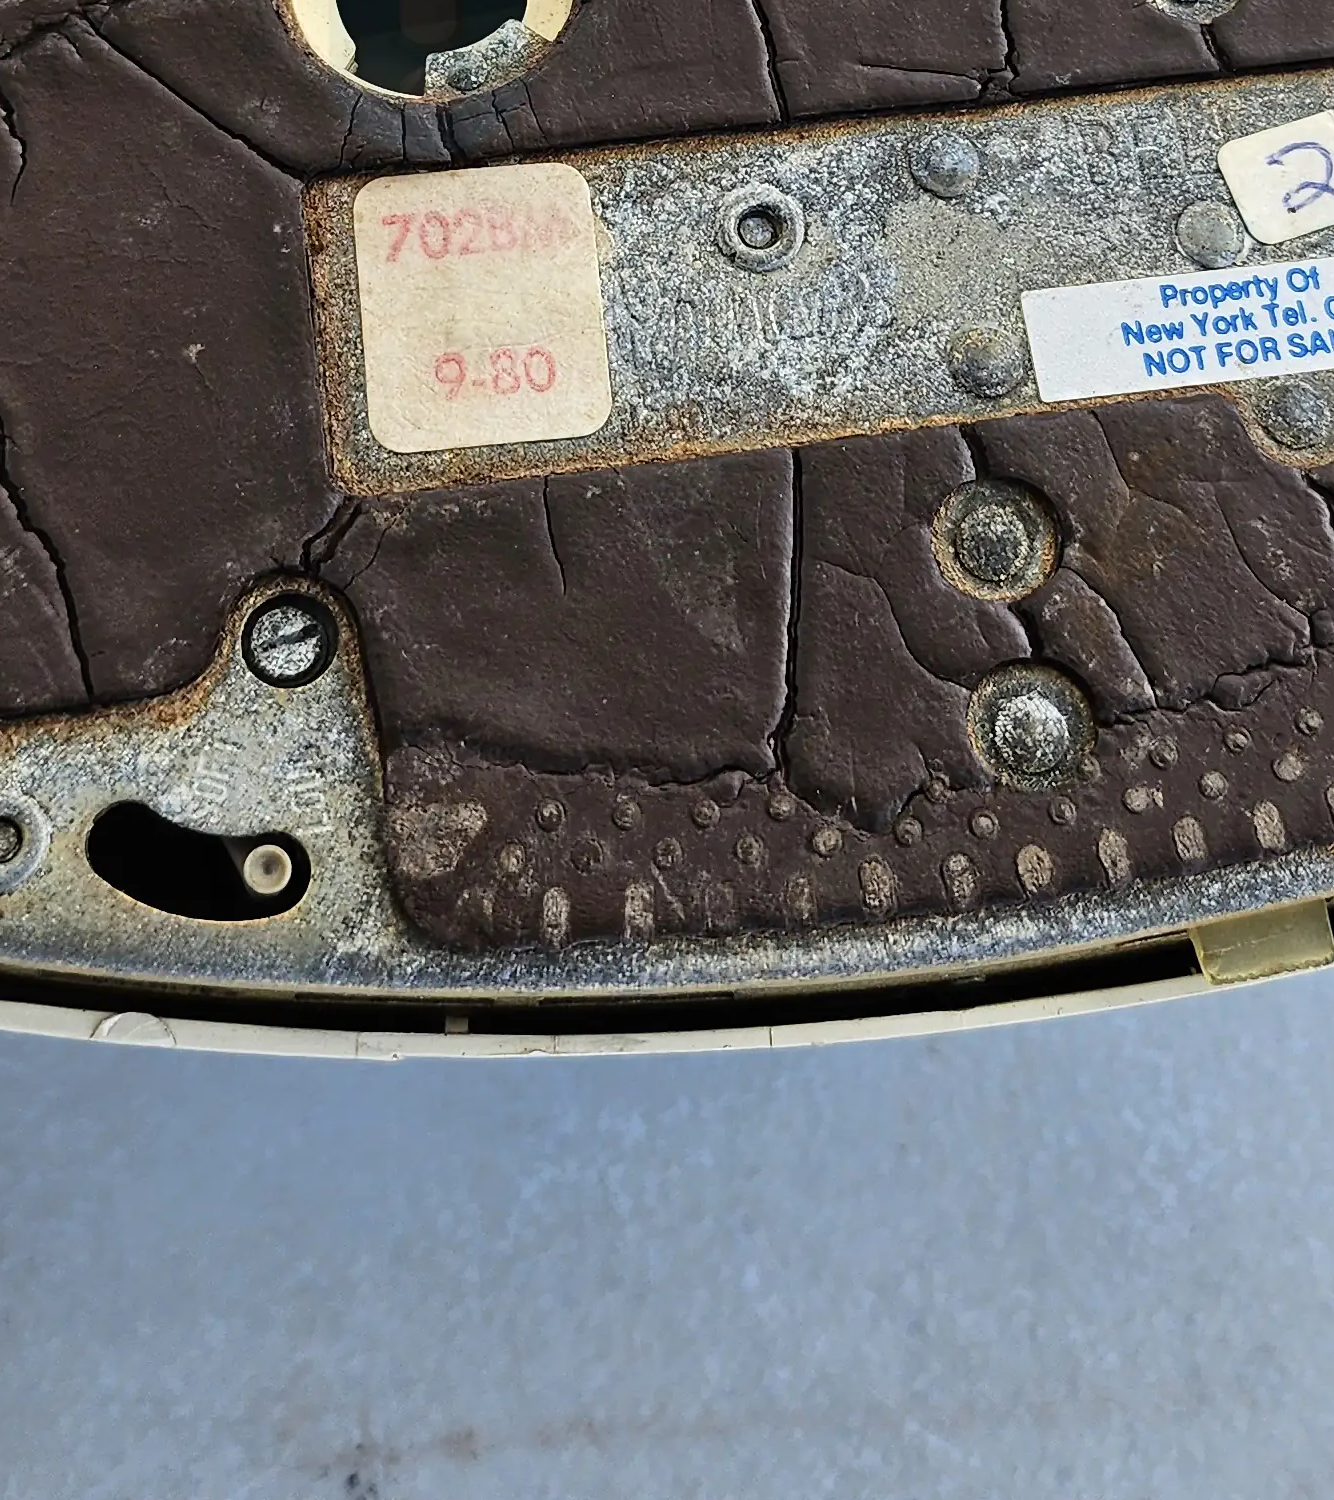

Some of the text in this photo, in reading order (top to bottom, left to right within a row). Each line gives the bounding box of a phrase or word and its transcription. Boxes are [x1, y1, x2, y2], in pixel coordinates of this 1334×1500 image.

[1159, 266, 1320, 309] Property Of
[1121, 320, 1184, 346] New
[1190, 307, 1257, 336] York
[1261, 300, 1317, 328] Tel.
[1142, 345, 1205, 377] NOT
[1215, 336, 1281, 367] FOR
